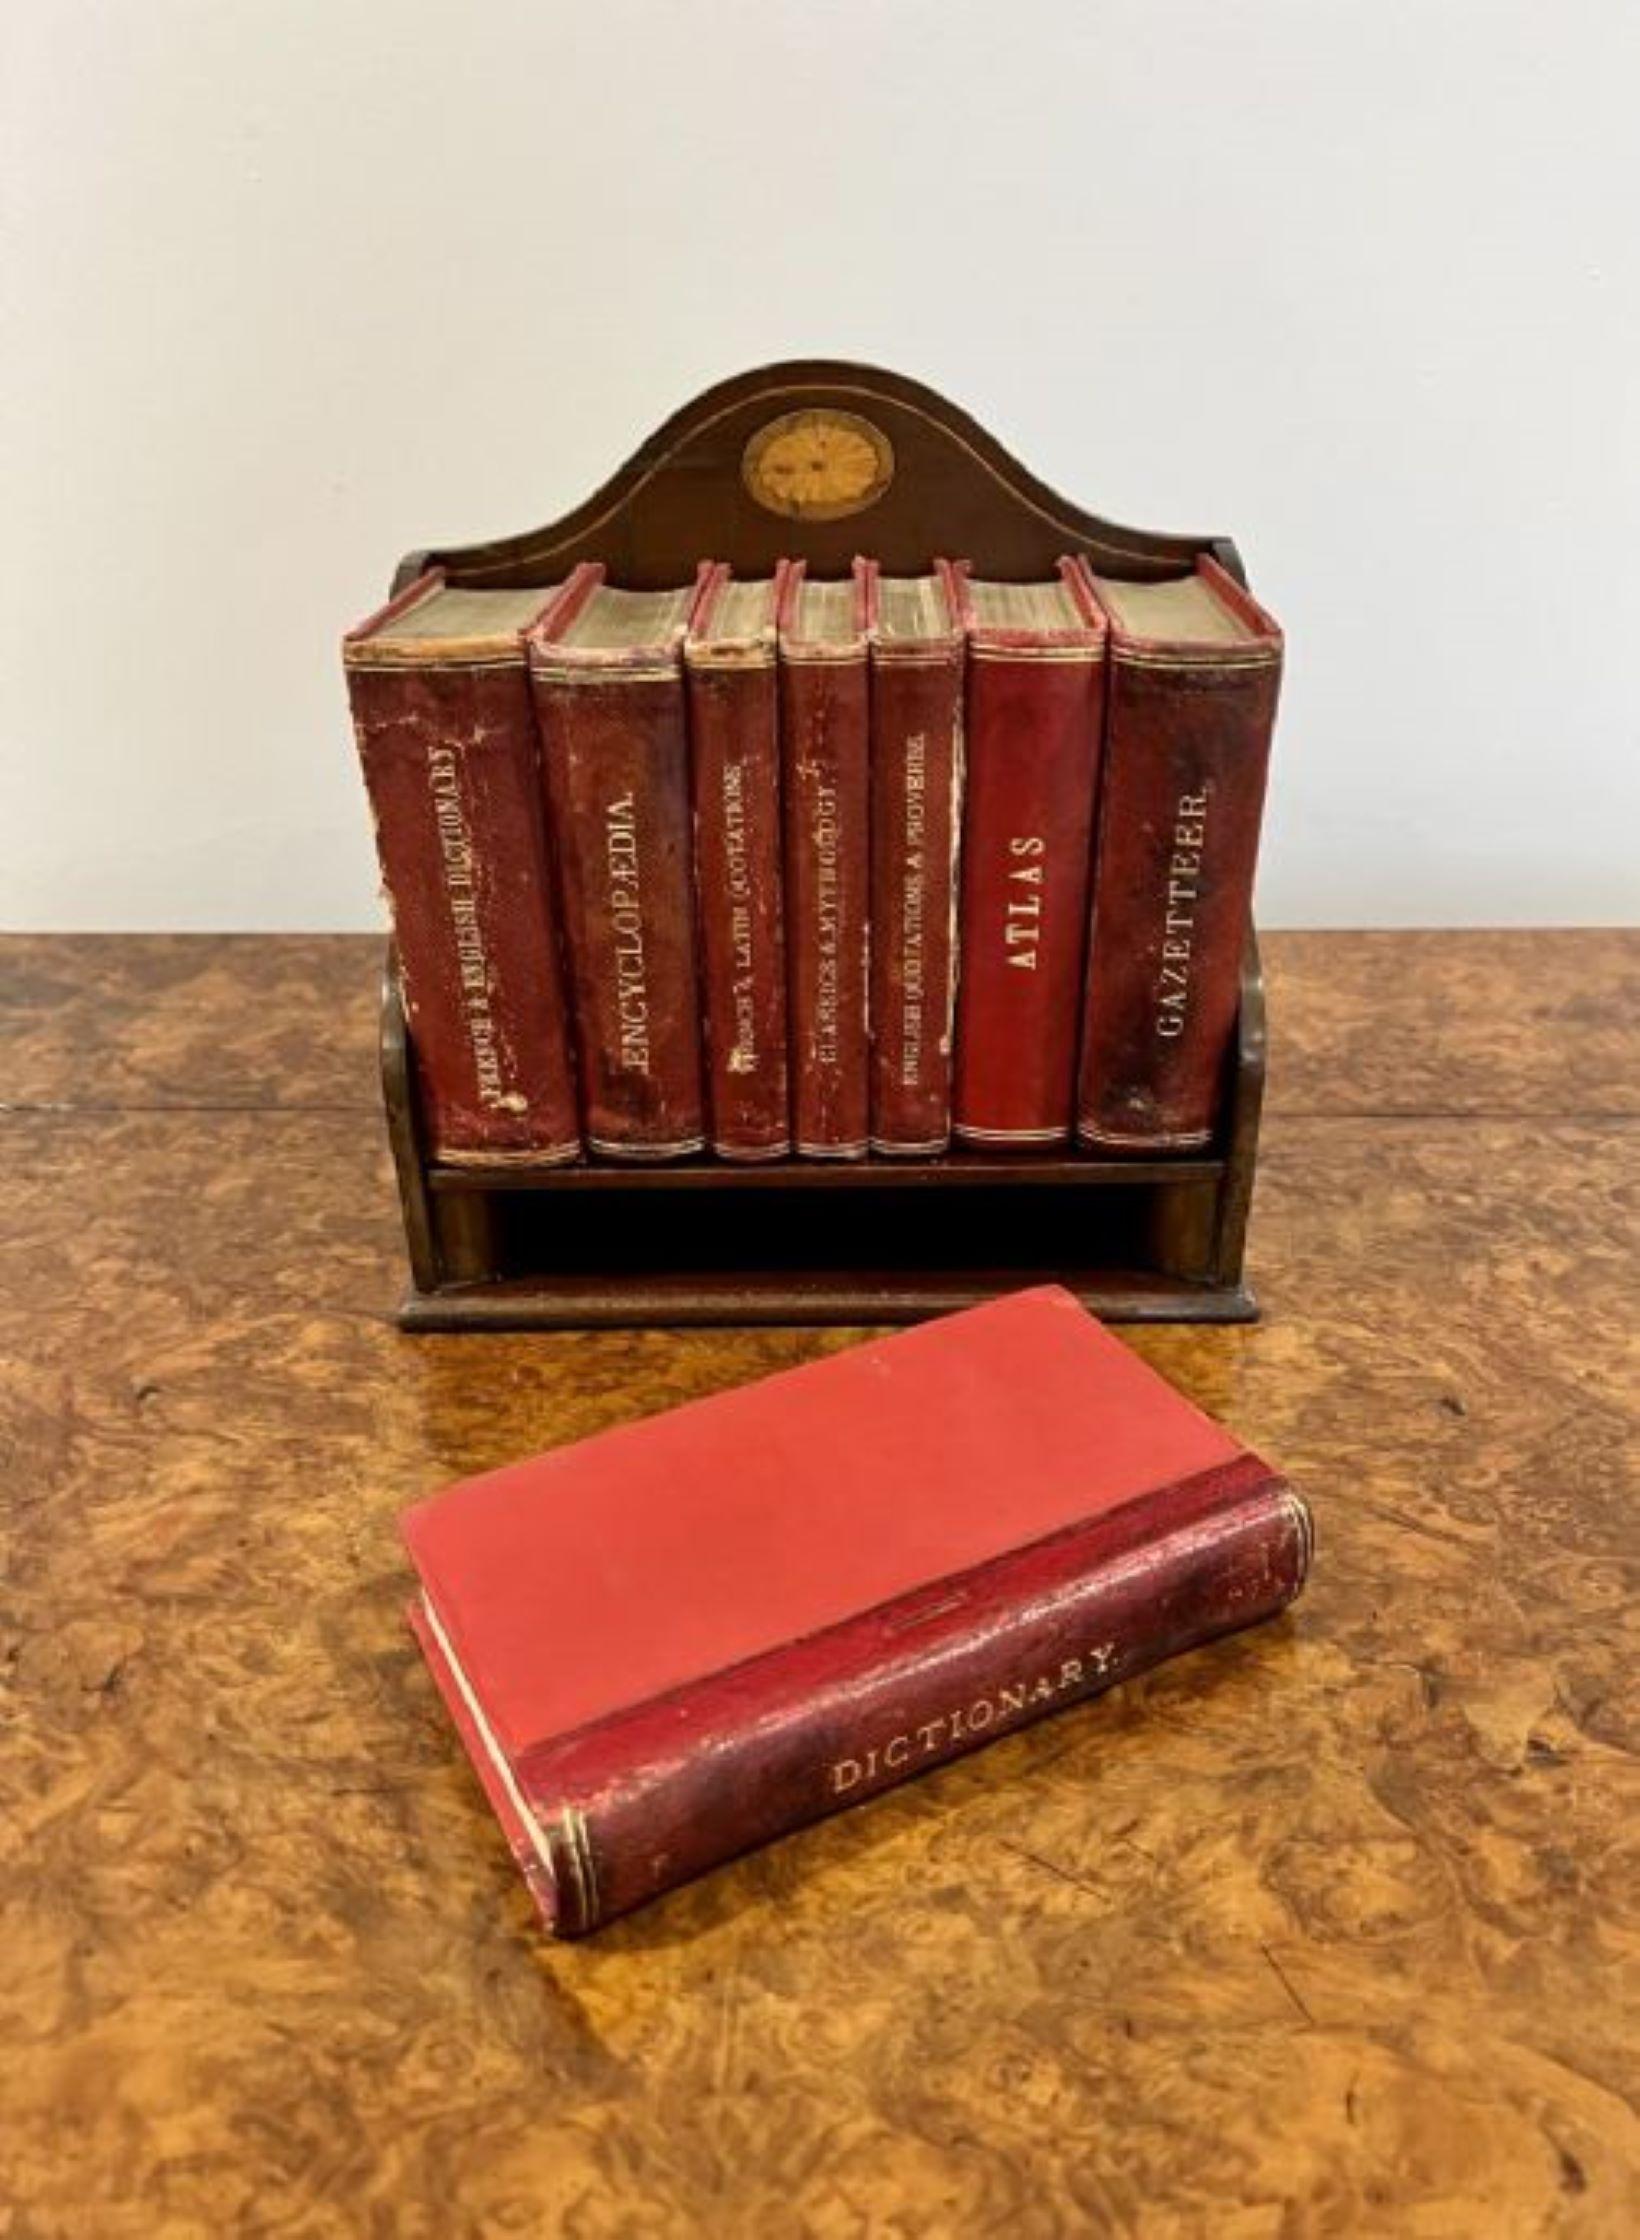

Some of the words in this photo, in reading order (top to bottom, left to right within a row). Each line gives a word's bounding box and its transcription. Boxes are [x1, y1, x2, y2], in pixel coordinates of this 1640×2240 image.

[452, 898, 487, 988] ENGLISH
[1005, 837, 1045, 970] ATLAS
[902, 1005, 922, 1086] ENGLISH
